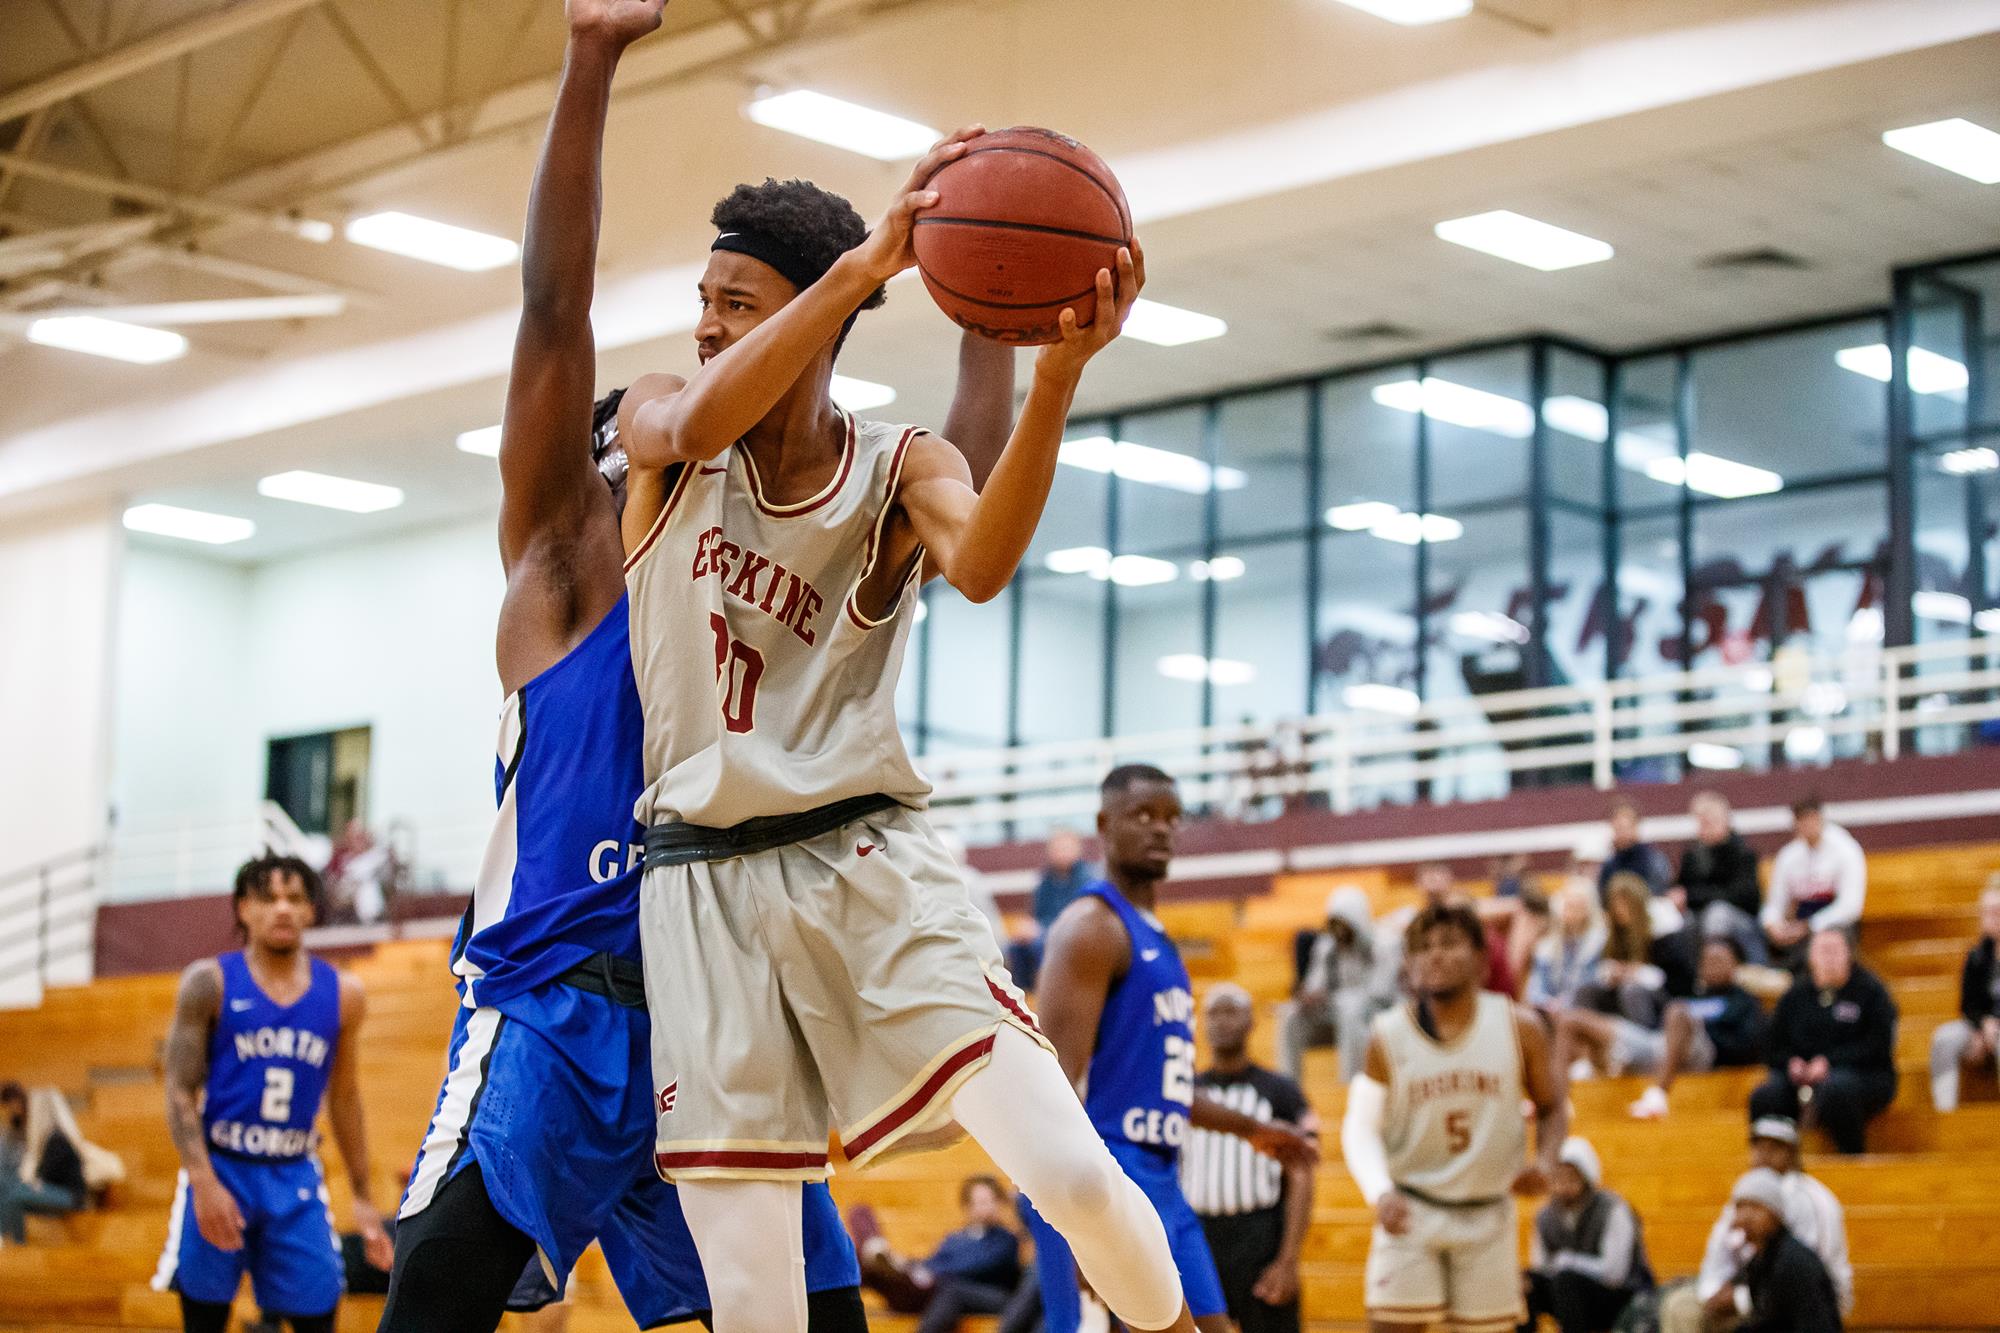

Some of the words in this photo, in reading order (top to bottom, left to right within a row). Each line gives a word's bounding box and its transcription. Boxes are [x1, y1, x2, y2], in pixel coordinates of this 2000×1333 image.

[234, 1026, 329, 1068] NORTH
[260, 1066, 294, 1122] 2
[1445, 1110, 1471, 1153] 5
